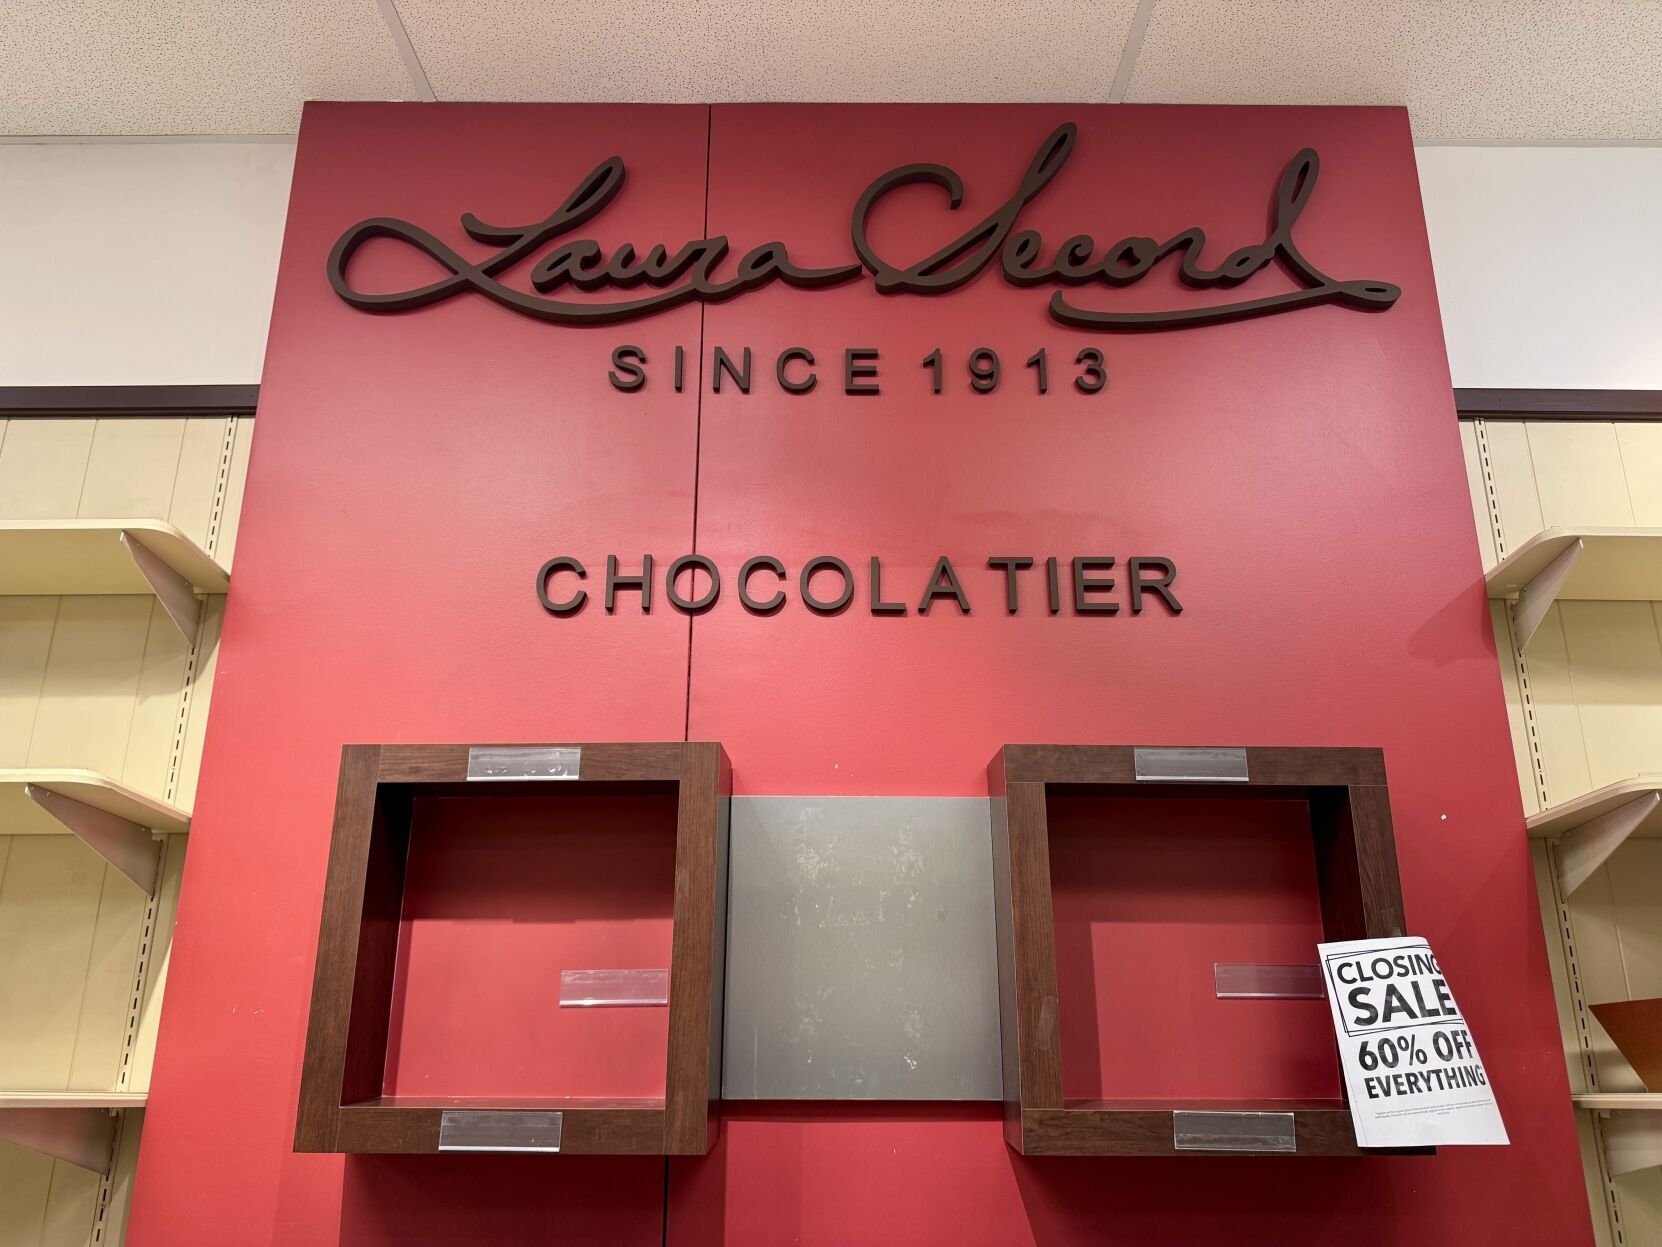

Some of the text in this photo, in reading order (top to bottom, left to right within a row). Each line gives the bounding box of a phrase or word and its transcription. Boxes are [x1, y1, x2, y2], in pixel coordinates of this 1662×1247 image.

[326, 122, 1402, 331] Laura Secord
[608, 344, 1108, 395] SINCE 1913
[536, 553, 1184, 616] CHOCOLATIER
[1347, 978, 1458, 1027] SALE
[1358, 1029, 1474, 1072] 60% OFF
